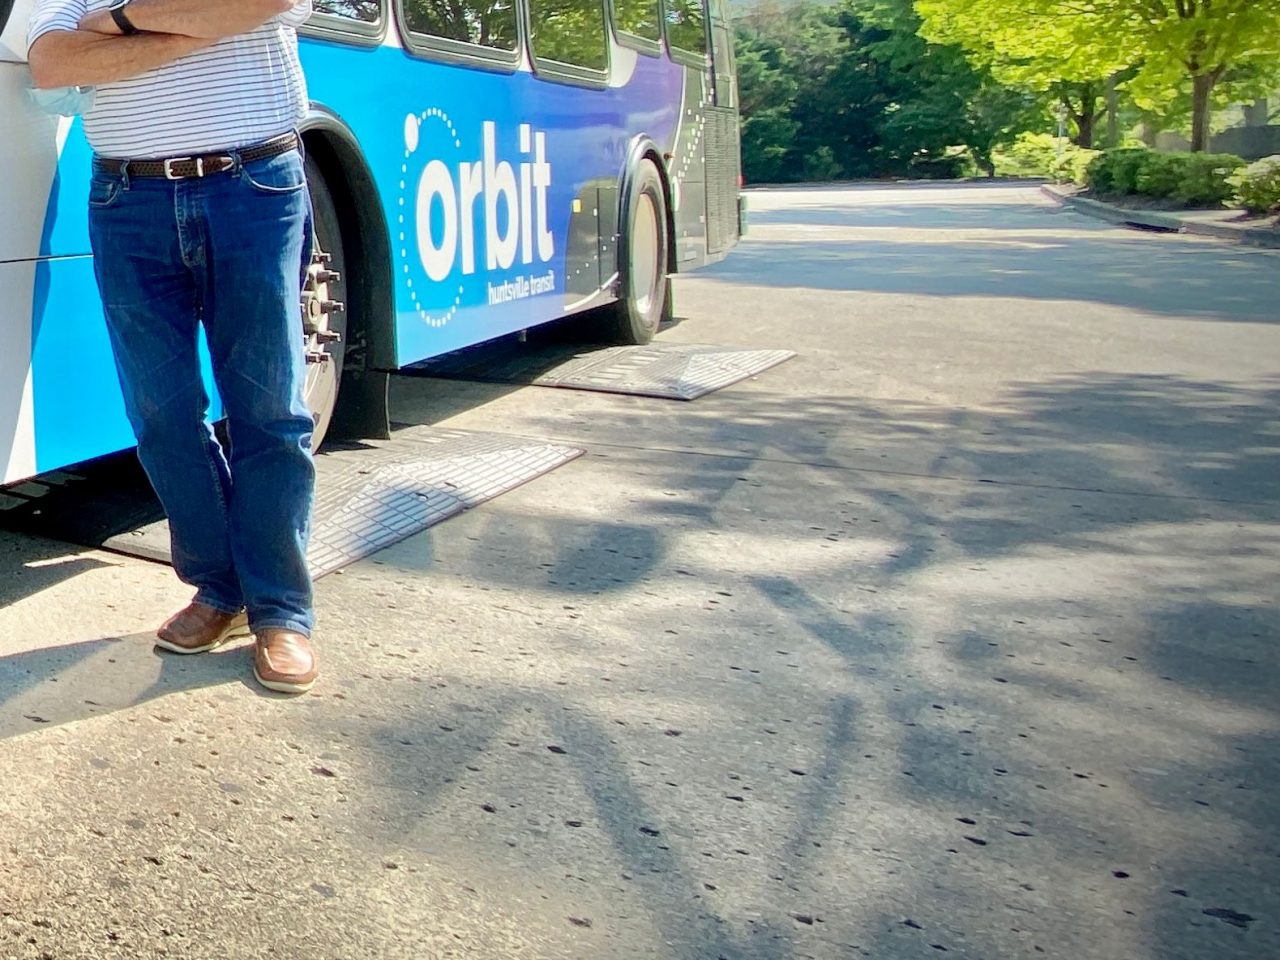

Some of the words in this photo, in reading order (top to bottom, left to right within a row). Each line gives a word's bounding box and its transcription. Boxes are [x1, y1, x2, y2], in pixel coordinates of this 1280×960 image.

[416, 120, 554, 282] orbit
[488, 275, 529, 305] huntsville
[530, 269, 555, 296] transit
